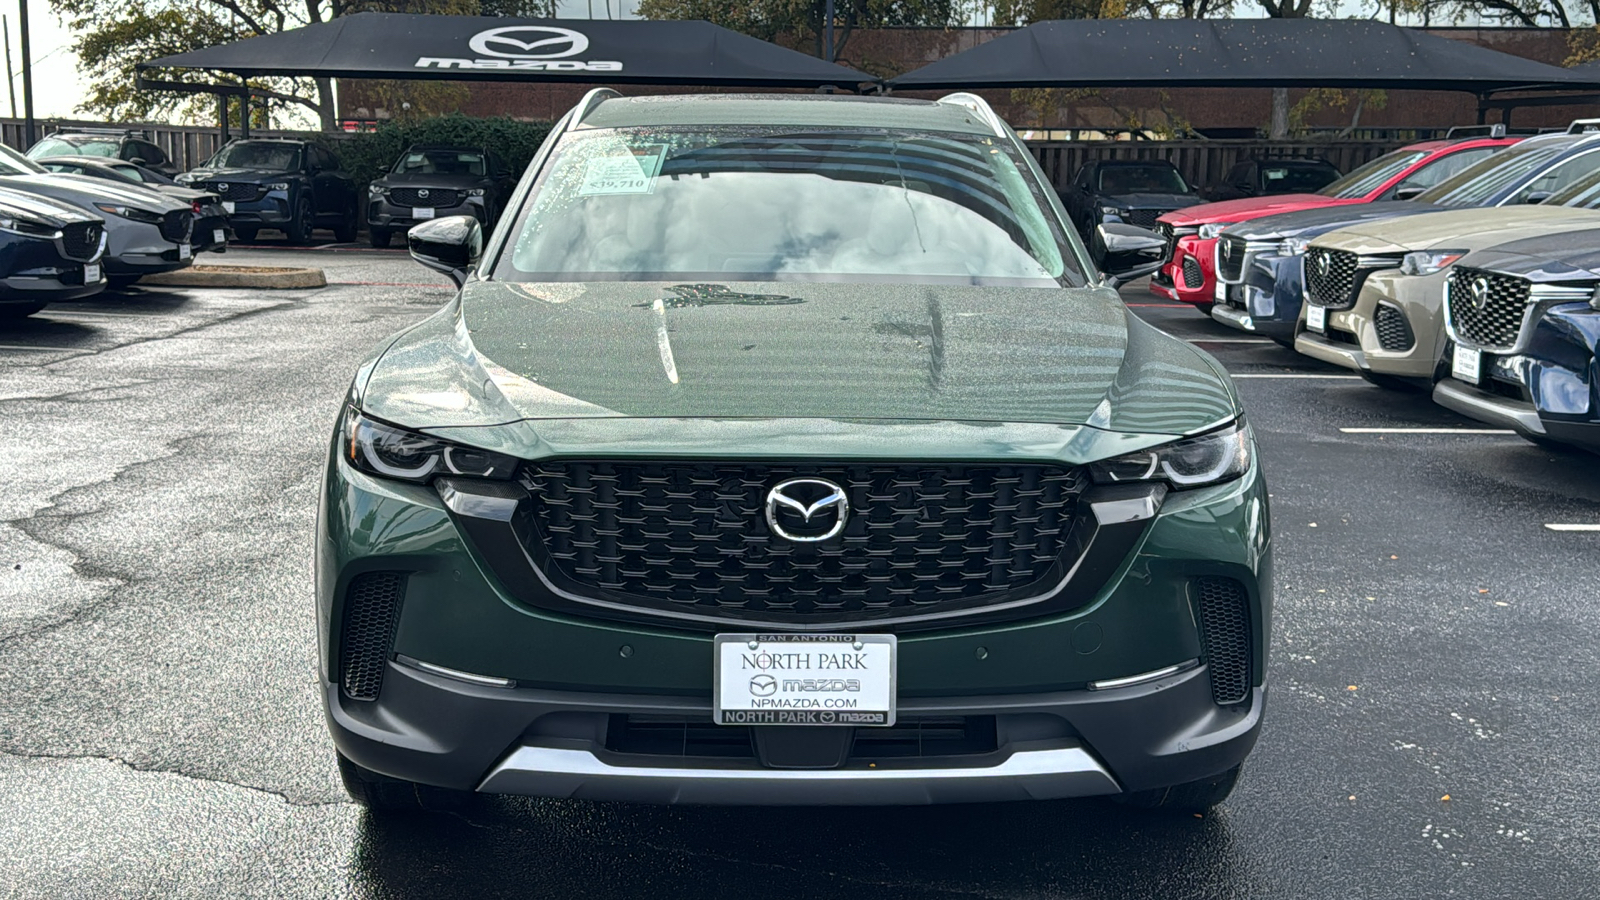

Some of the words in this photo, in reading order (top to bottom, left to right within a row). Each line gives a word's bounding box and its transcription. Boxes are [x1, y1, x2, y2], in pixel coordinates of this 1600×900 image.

[414, 56, 623, 71] mazda
[741, 653, 810, 670] NORTH
[818, 653, 868, 670] PARK
[782, 678, 861, 692] mazda
[751, 698, 857, 708] NPMAZDA.COM
[725, 711, 774, 723] NORTH
[778, 711, 817, 723] PARK
[839, 713, 884, 722] mazda
